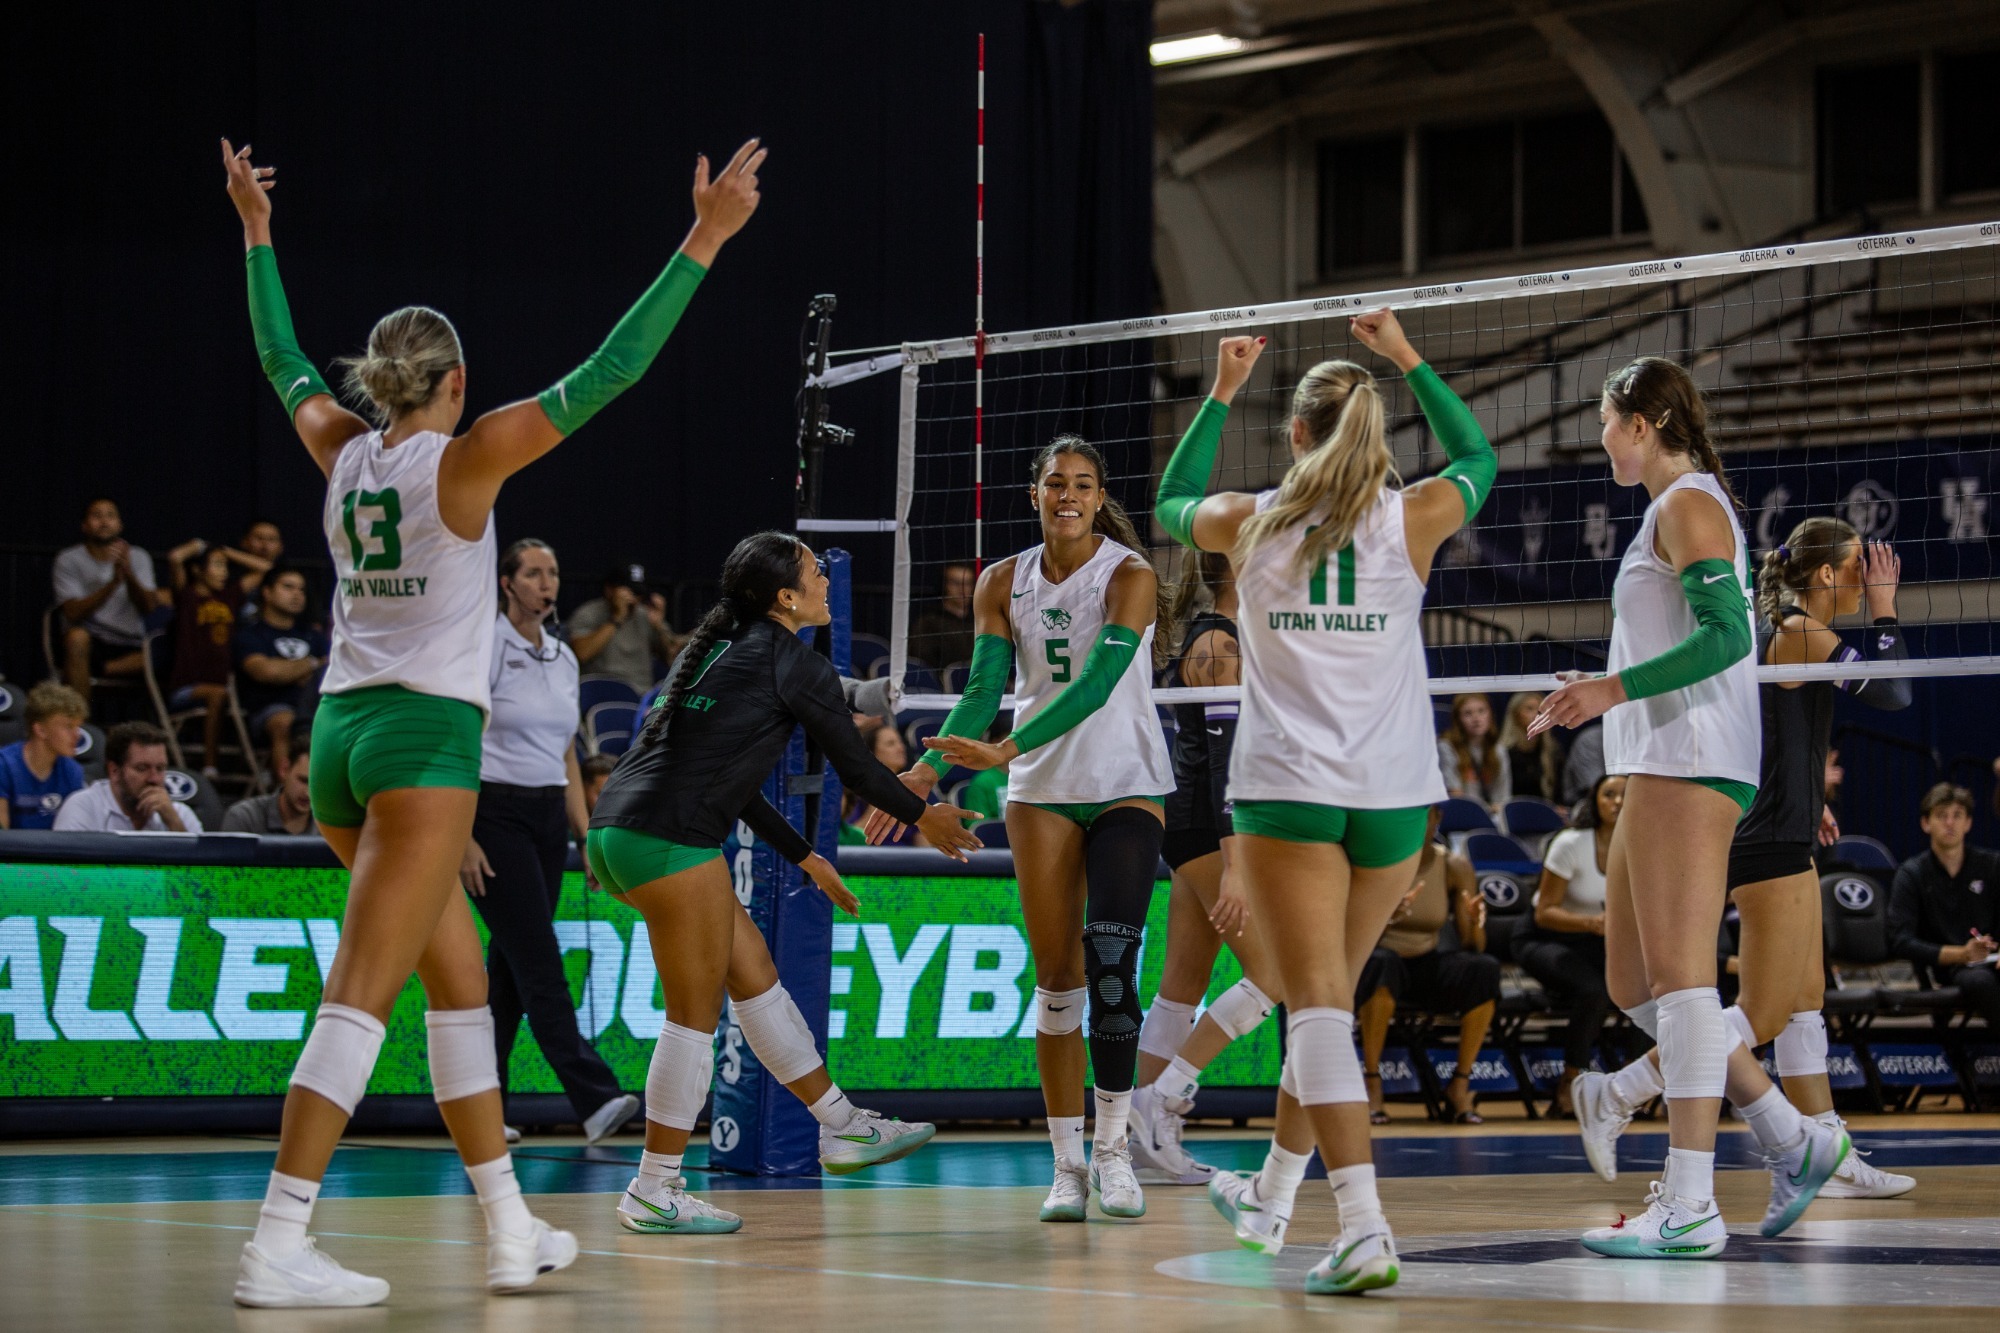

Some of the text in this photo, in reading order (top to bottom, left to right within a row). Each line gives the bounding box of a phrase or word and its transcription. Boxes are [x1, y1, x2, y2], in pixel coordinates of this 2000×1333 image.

[342, 487, 402, 571] 13
[366, 576, 428, 597] VALLEY
[1268, 611, 1388, 632] UTAH VALLEY
[1045, 638, 1071, 683] 5
